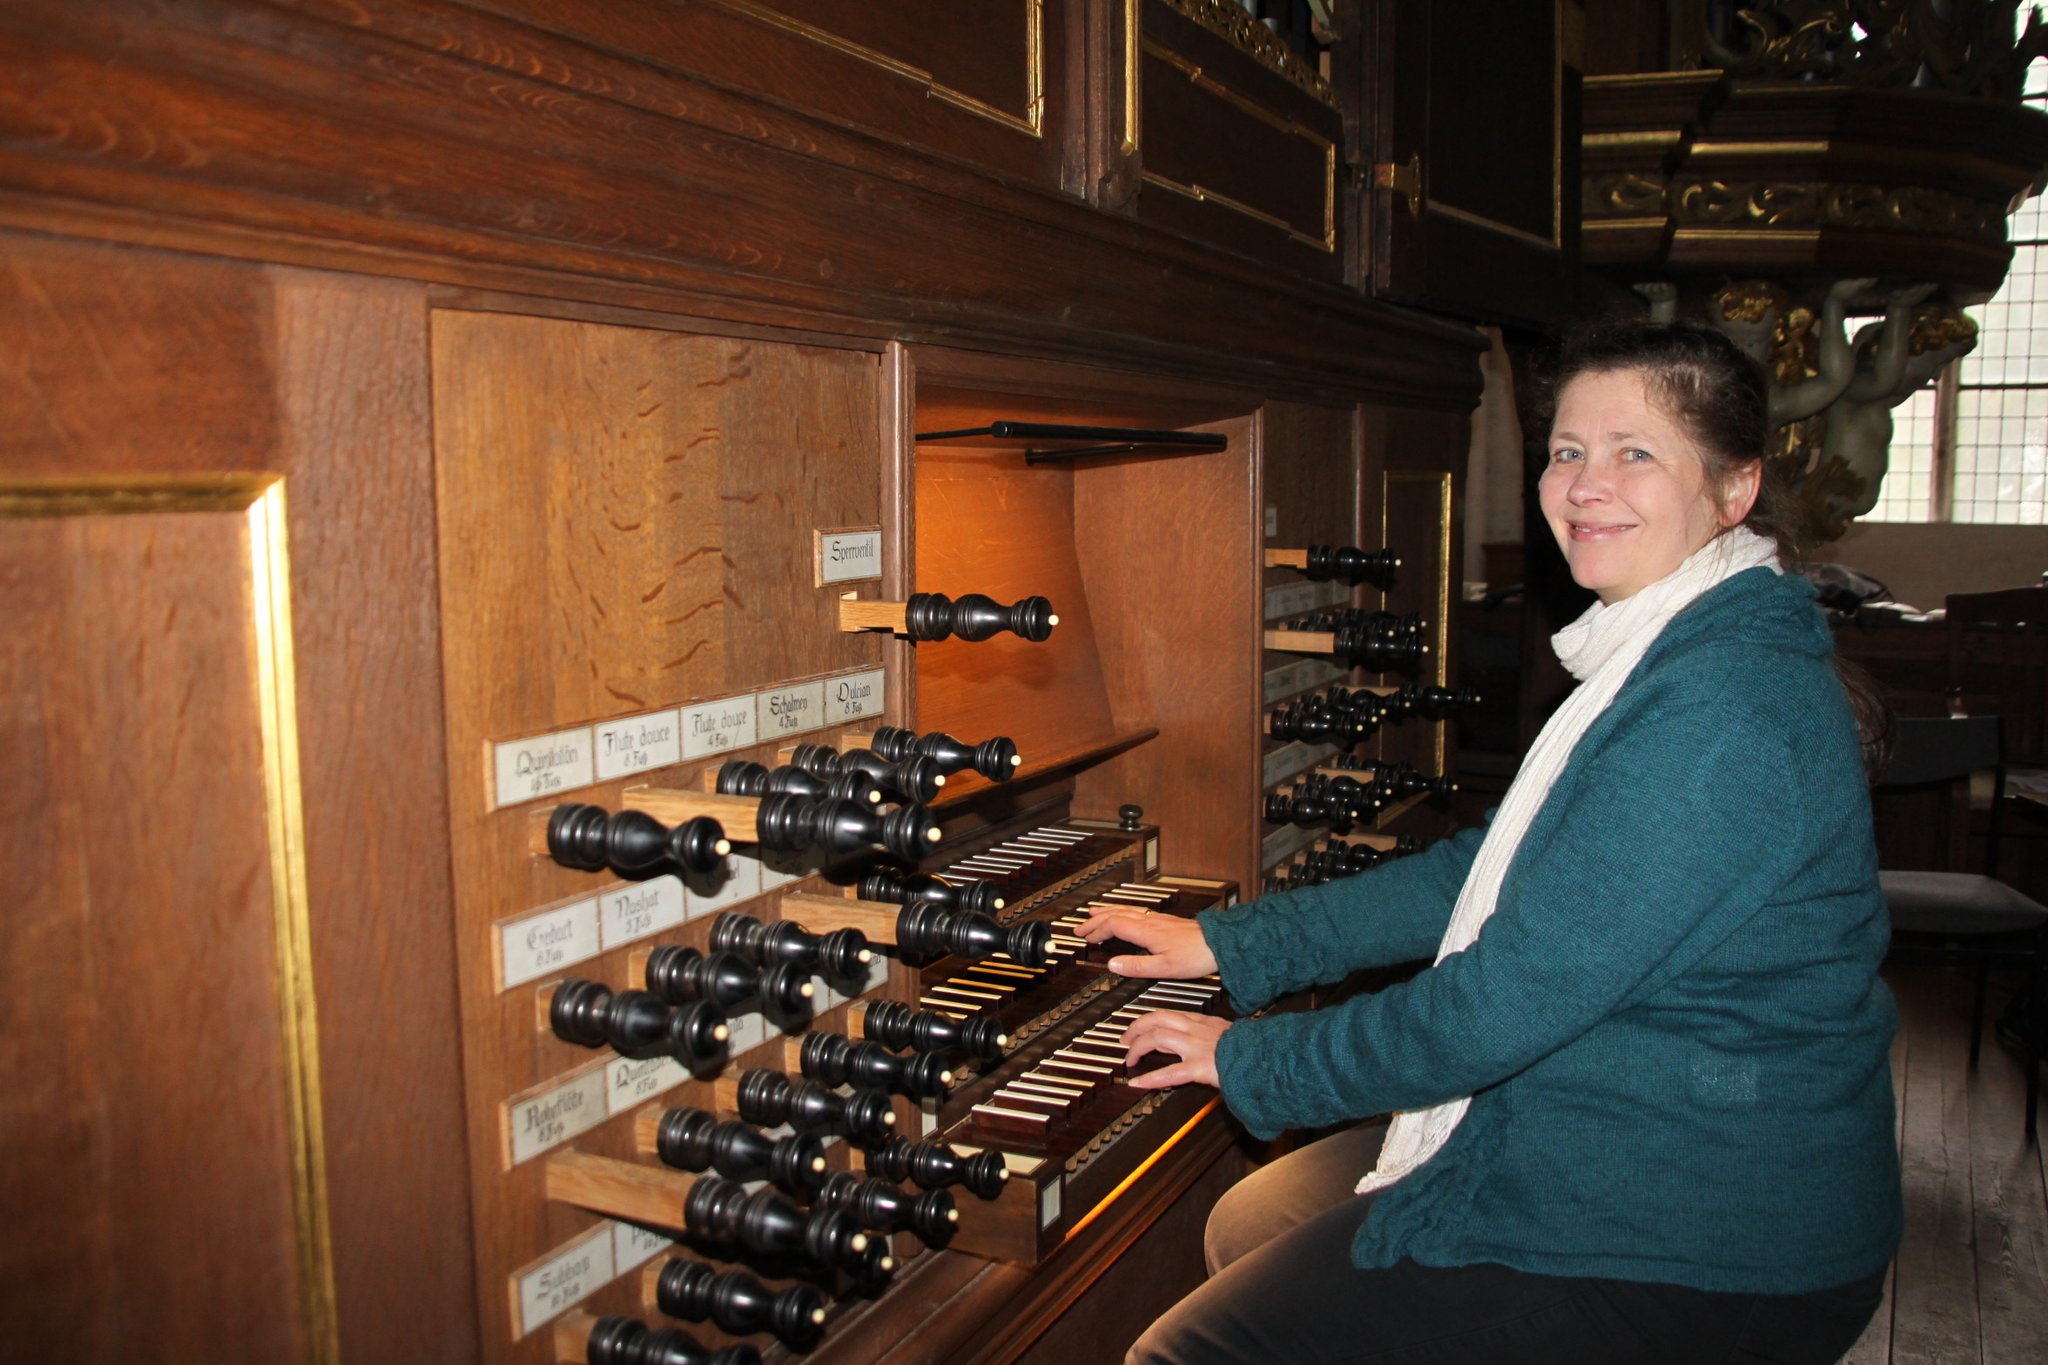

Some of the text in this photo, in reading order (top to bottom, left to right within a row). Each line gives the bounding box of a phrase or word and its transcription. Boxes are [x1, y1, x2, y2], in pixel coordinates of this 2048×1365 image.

[831, 537, 873, 564] Sperrventil
[836, 682, 871, 703] Dulcian
[769, 694, 808, 717] Schalmey
[844, 703, 850, 714] 8
[779, 716, 785, 728] 4
[603, 731, 634, 757] Flute
